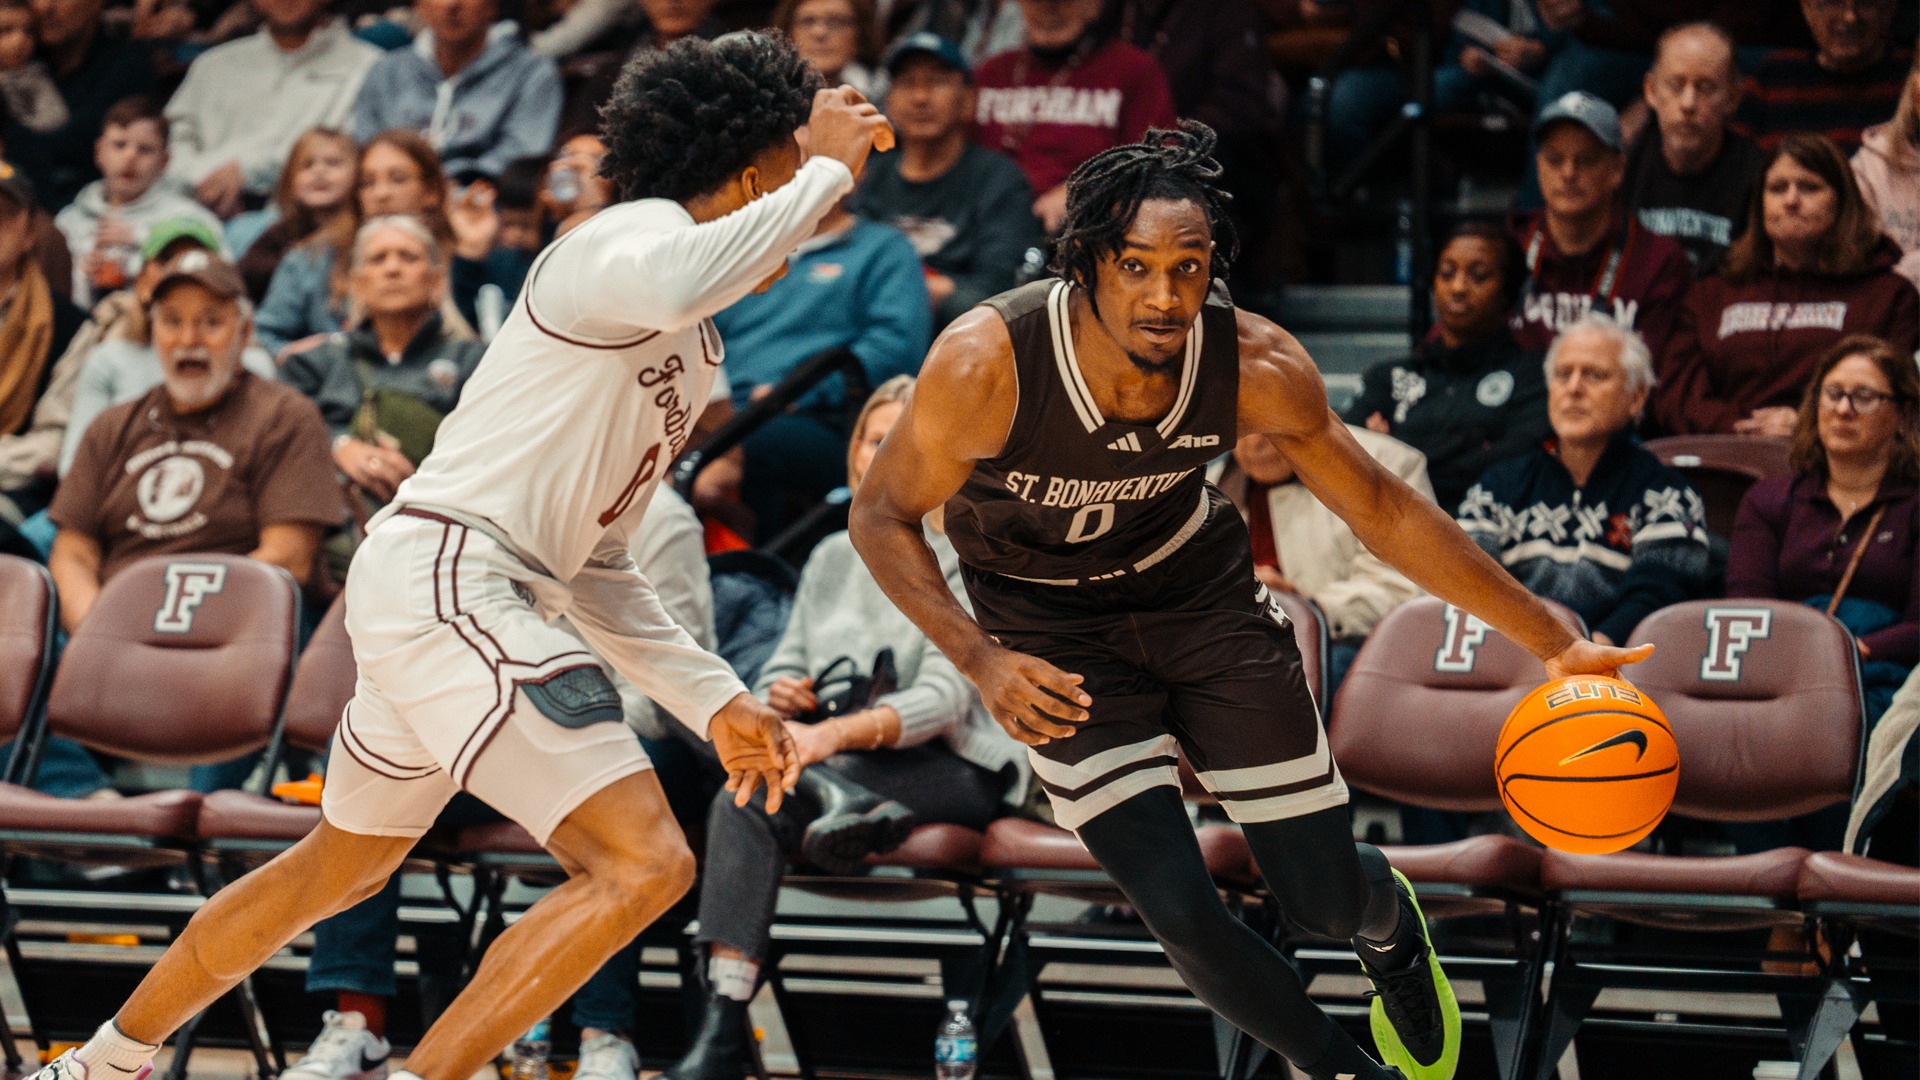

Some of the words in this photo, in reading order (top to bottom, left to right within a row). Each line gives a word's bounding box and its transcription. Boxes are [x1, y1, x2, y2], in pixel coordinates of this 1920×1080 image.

[1167, 434, 1220, 449] A10
[1005, 471, 1040, 503] ST.
[1042, 466, 1197, 508] BONAVENTU
[1065, 502, 1115, 544] 0
[153, 563, 226, 633] F
[1699, 608, 1772, 681] F
[1545, 683, 1643, 710] ELITE
